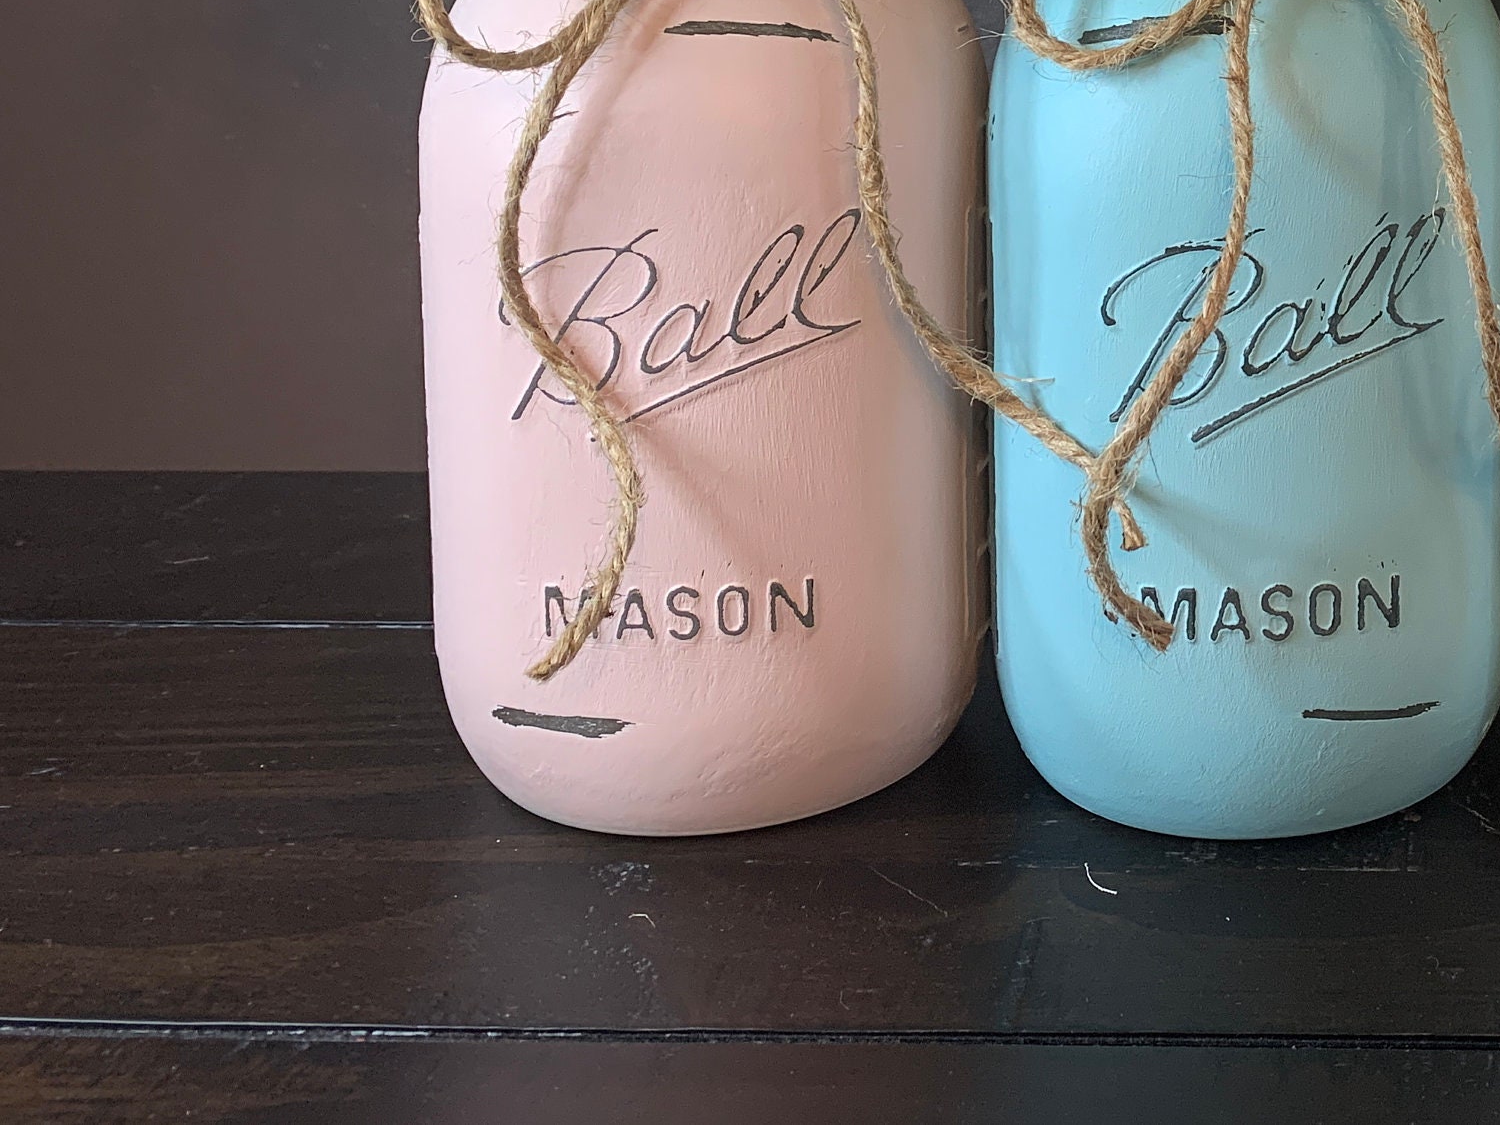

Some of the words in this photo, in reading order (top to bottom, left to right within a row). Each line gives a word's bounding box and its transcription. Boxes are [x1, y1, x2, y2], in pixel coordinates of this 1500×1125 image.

[498, 209, 862, 423] Ball
[1101, 206, 1444, 442] Ball
[544, 578, 815, 640] MASON
[1140, 574, 1401, 642] MASON
